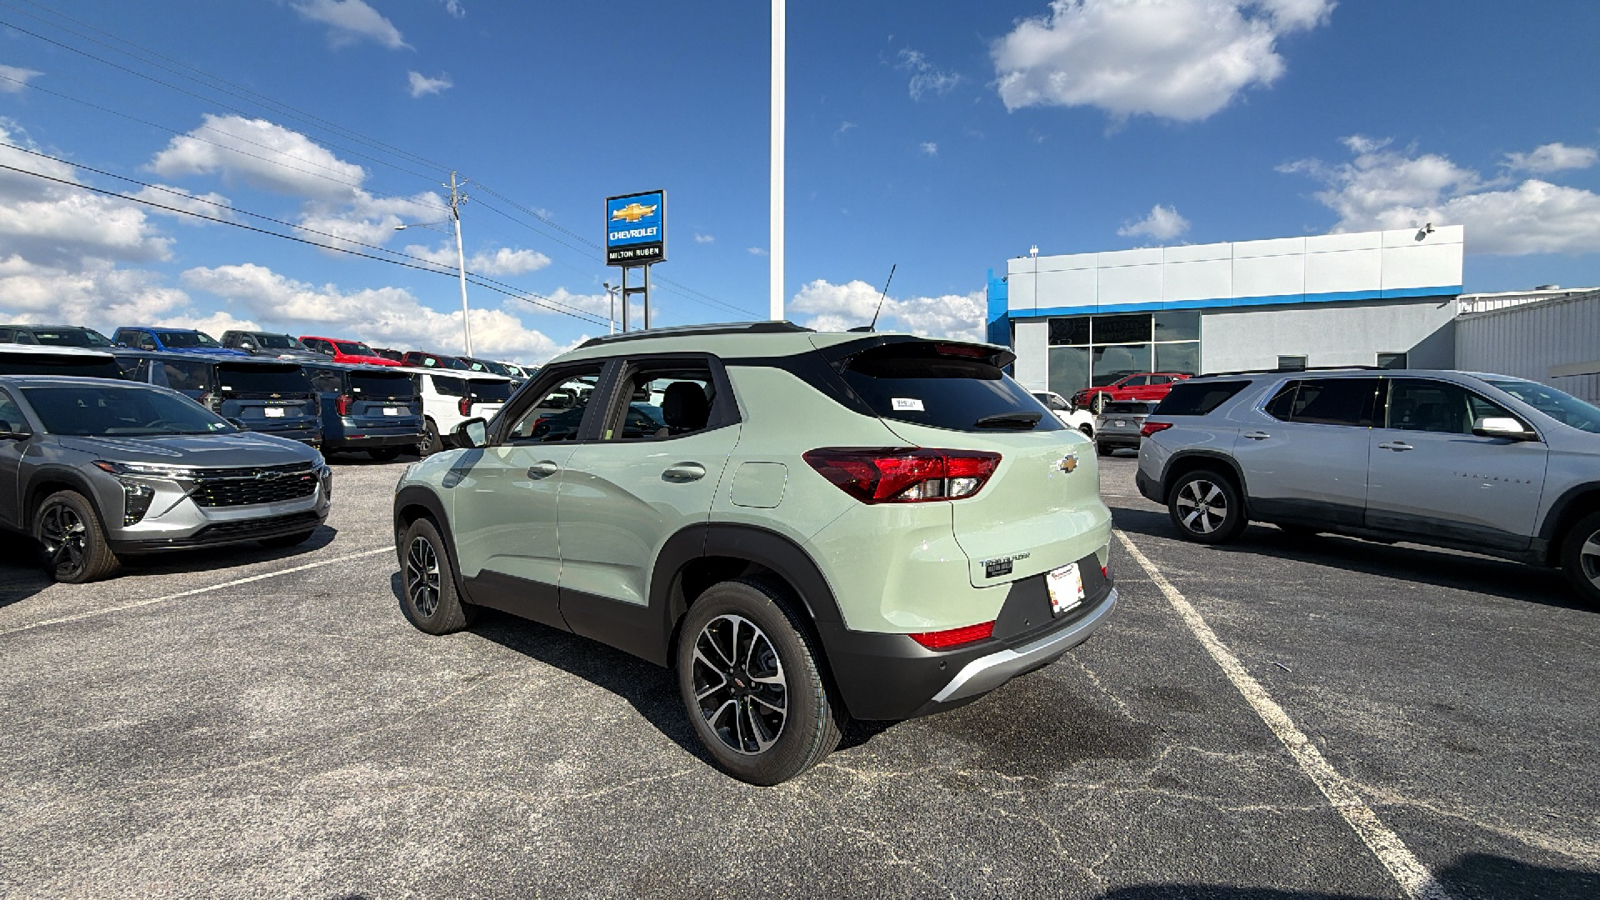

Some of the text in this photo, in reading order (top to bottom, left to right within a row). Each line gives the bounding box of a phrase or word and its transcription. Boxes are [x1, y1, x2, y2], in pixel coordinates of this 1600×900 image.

[610, 226, 657, 240] CHEVROLET
[609, 248, 659, 259] MILTON RUBEN
